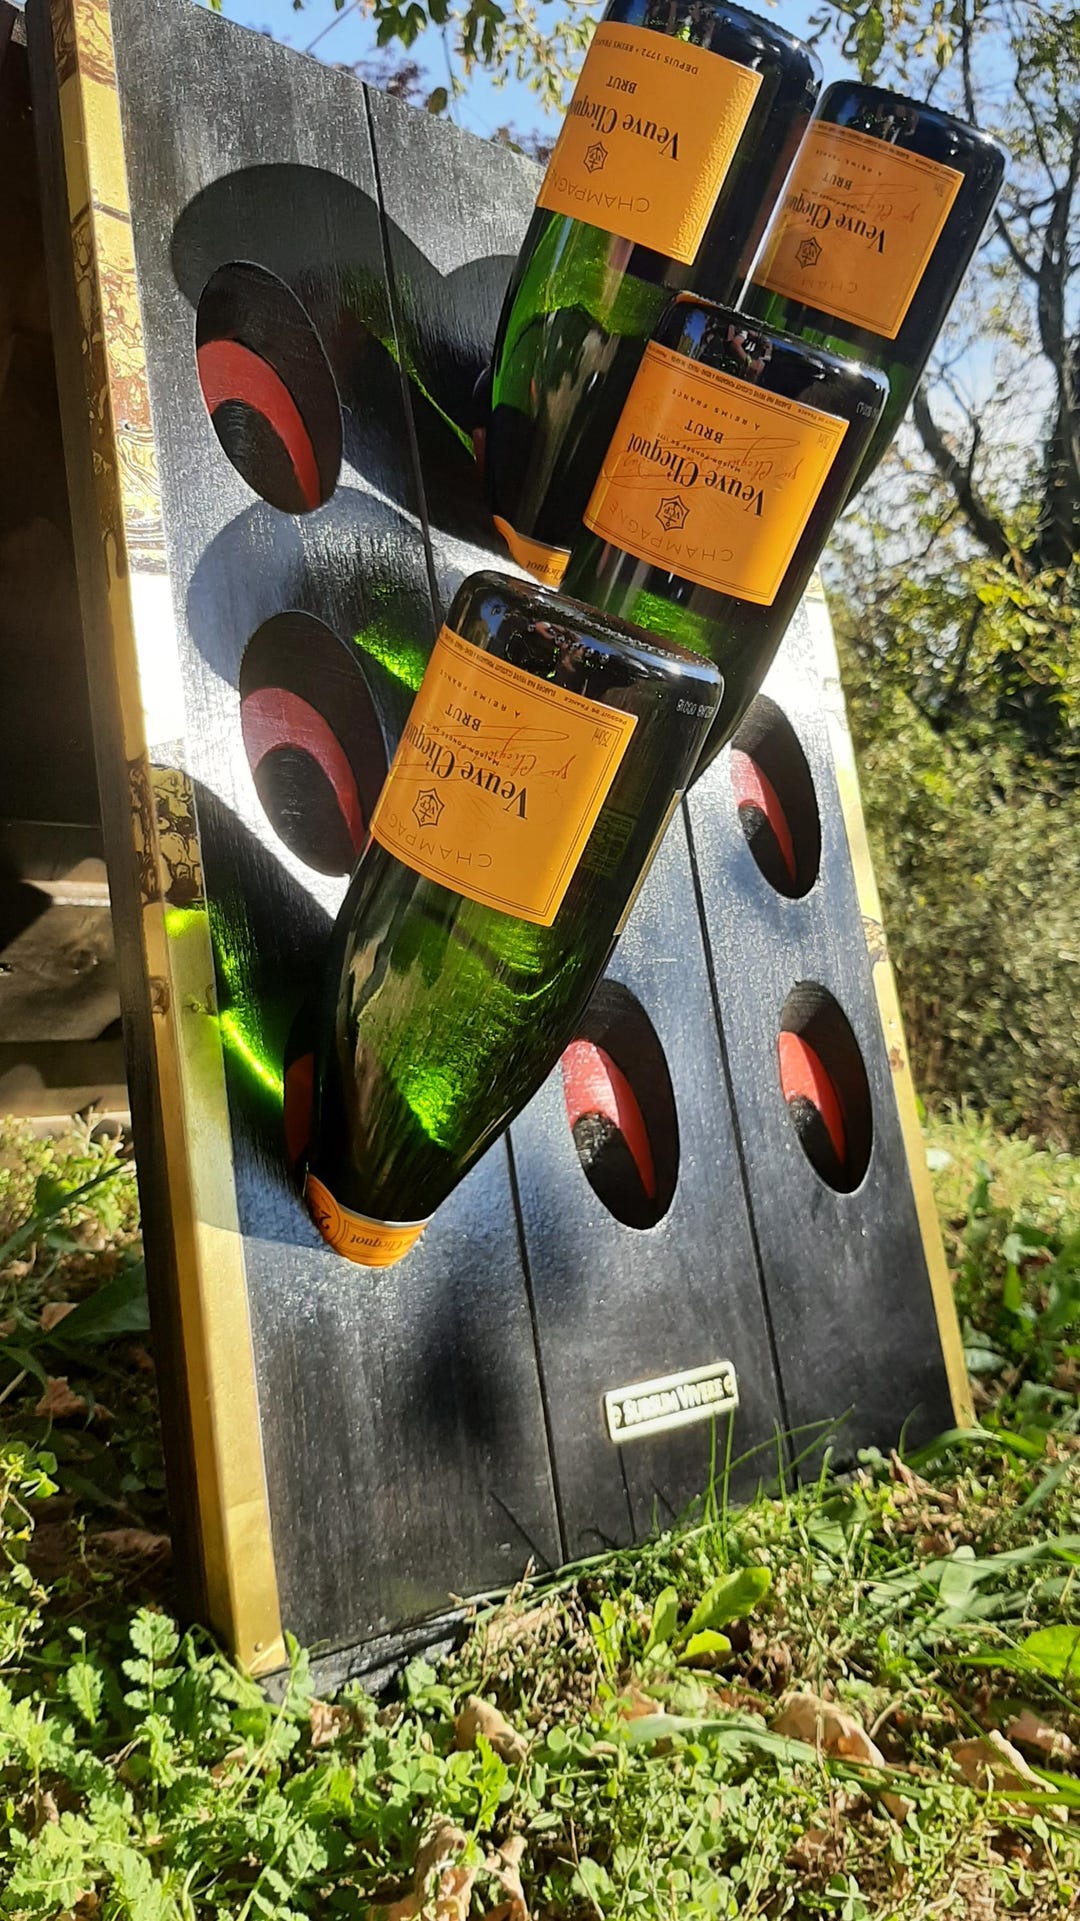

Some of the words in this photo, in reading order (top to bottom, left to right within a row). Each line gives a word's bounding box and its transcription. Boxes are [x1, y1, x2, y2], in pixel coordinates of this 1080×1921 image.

[640, 47, 662, 61] 1772
[663, 55, 699, 74] DEPUIS
[605, 75, 637, 93] BRUT
[567, 95, 619, 133] Clicqu
[622, 113, 678, 161] Veuve
[822, 171, 853, 190] BRUT
[834, 211, 884, 254] Veuve
[670, 388, 708, 409] FRANCE
[712, 406, 749, 425] REIMS
[684, 418, 725, 444] BRUT
[624, 433, 700, 486] Clicquot
[703, 469, 763, 517] Veuve
[607, 500, 733, 562] CHAMPAGNE
[472, 690, 507, 710] REIMS
[564, 696, 590, 711] FRANCE
[444, 702, 482, 731] BRUT
[401, 722, 457, 777] Clicqu
[458, 760, 527, 820] Veuve
